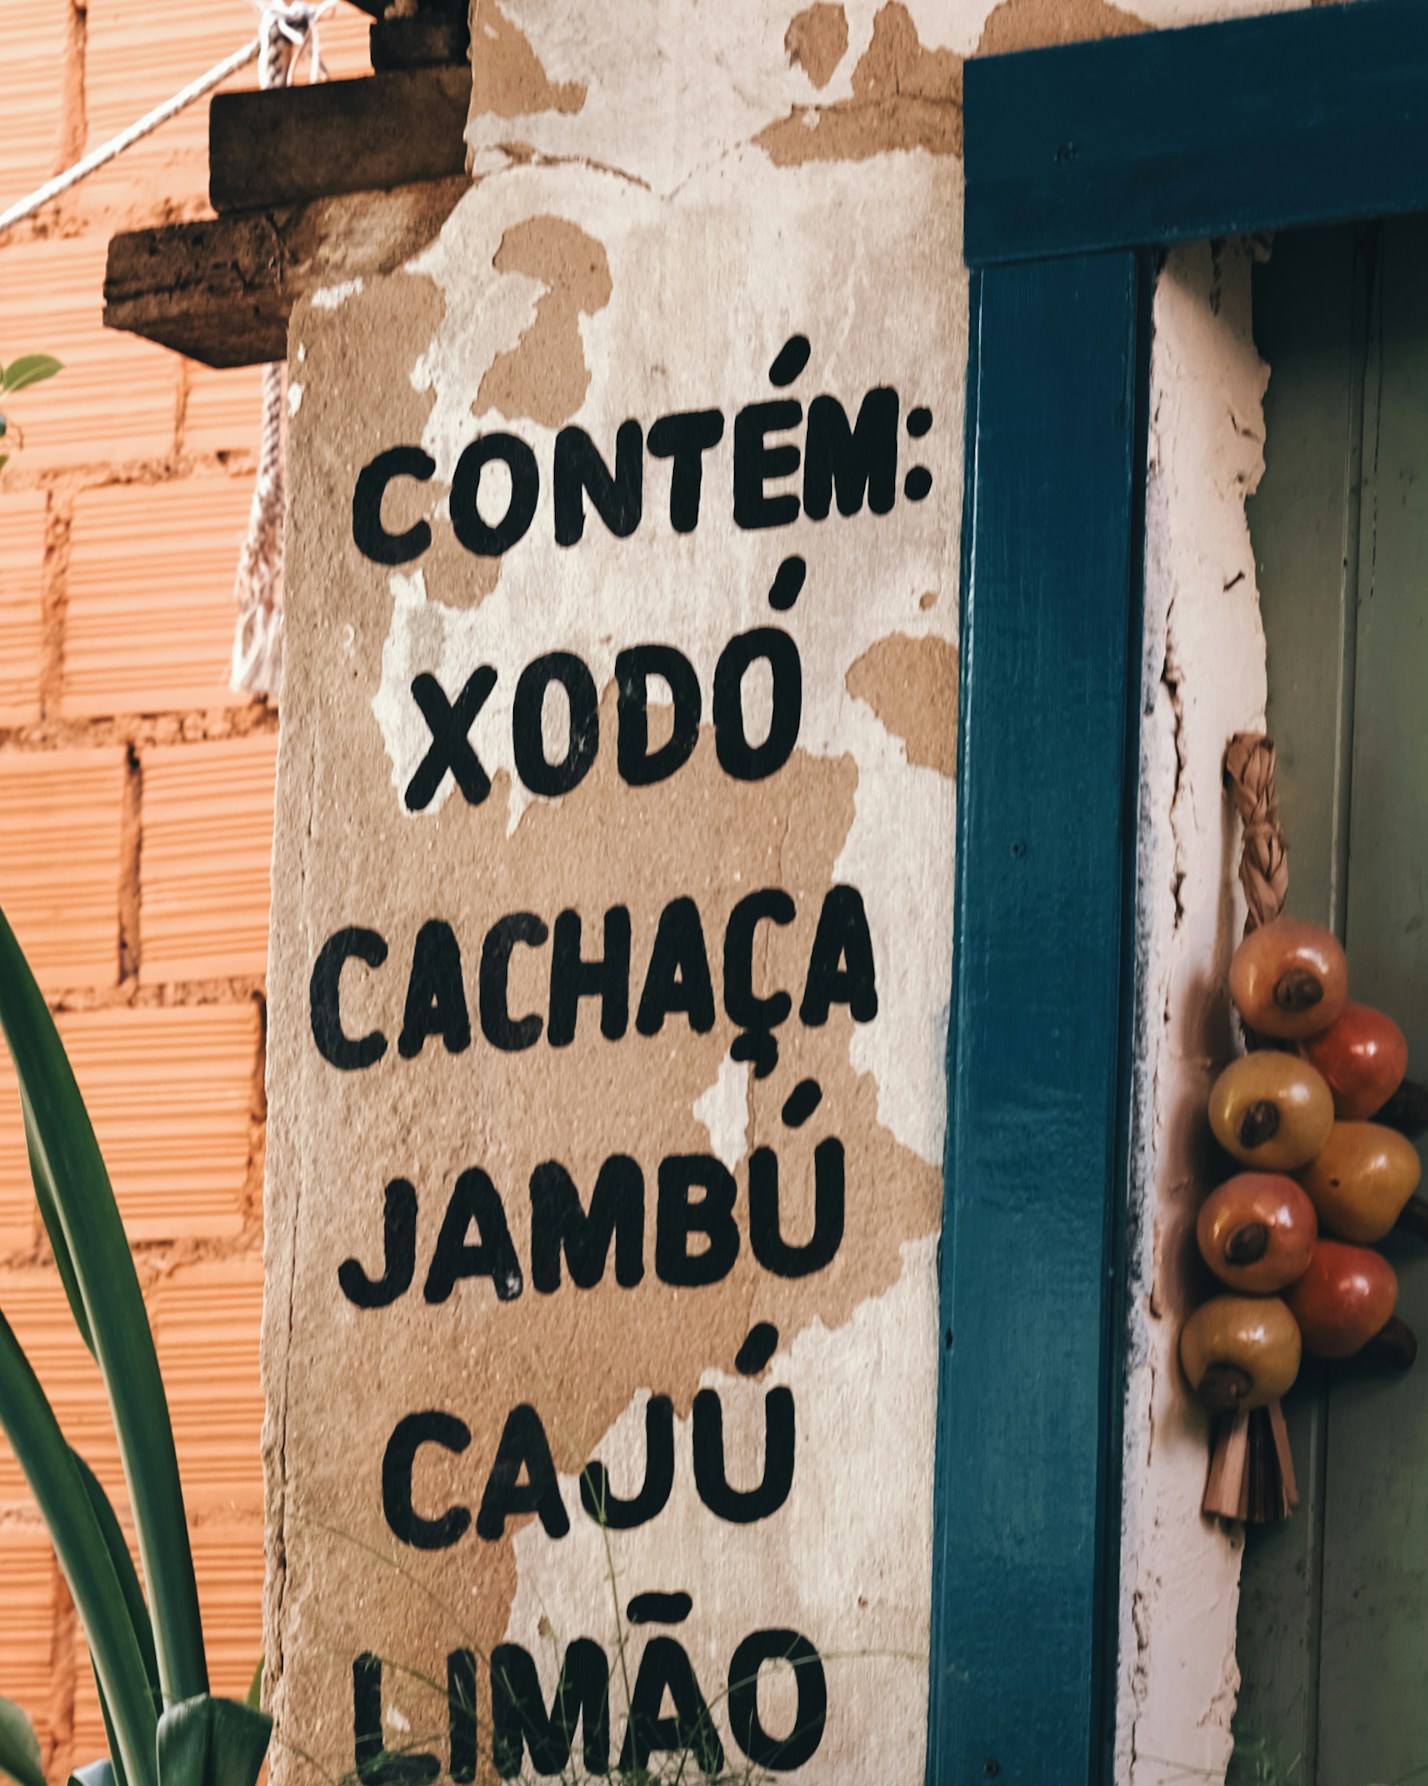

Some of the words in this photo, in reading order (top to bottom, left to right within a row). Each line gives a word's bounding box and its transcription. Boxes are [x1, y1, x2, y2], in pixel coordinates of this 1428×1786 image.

[352, 334, 933, 566] CONTÉM:
[404, 555, 807, 812] XODÓ
[309, 884, 879, 1080] CACHAÇA
[337, 1078, 846, 1310] JAMBÚ
[381, 1322, 797, 1551] CAJÚ
